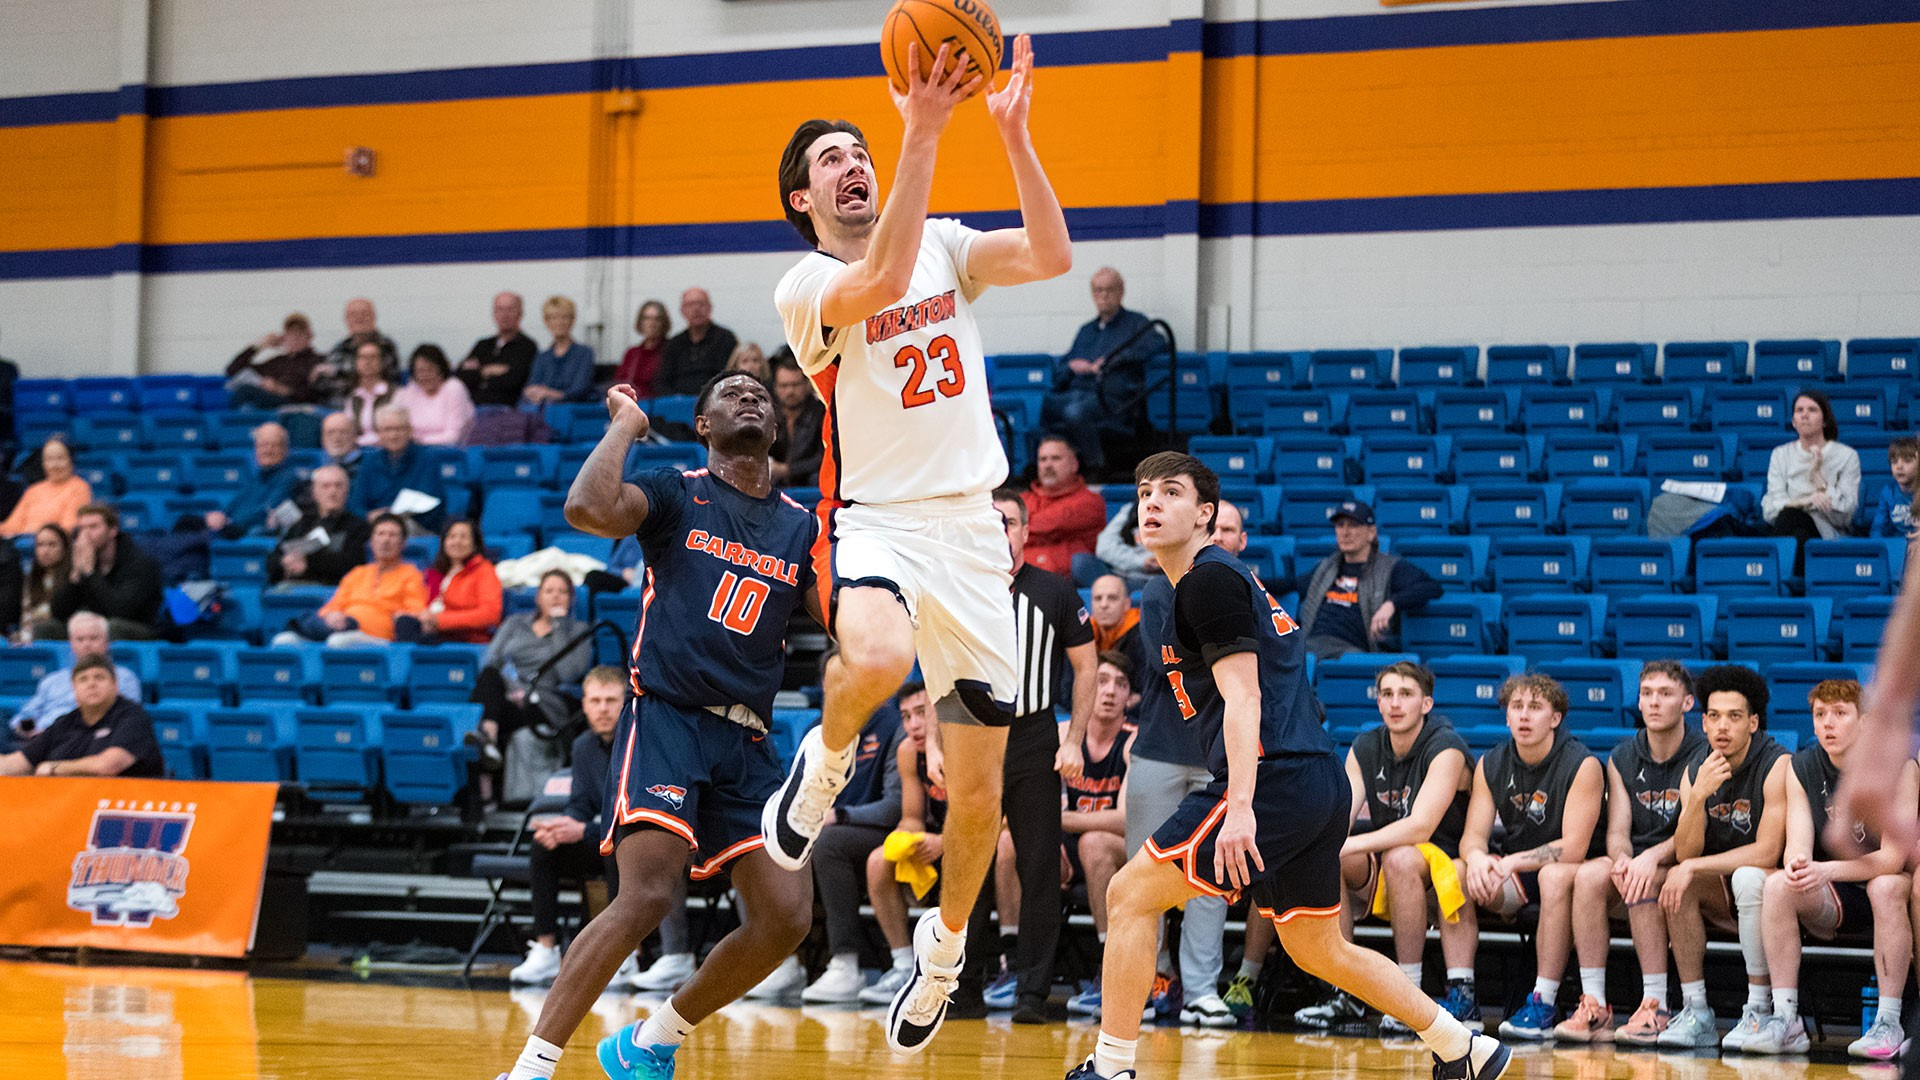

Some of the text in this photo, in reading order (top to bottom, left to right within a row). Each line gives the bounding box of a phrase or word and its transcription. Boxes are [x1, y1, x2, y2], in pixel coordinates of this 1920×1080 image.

[866, 289, 956, 345] WHEATON
[893, 334, 966, 409] 23
[685, 529, 799, 587] CARROLL
[707, 570, 771, 636] 10
